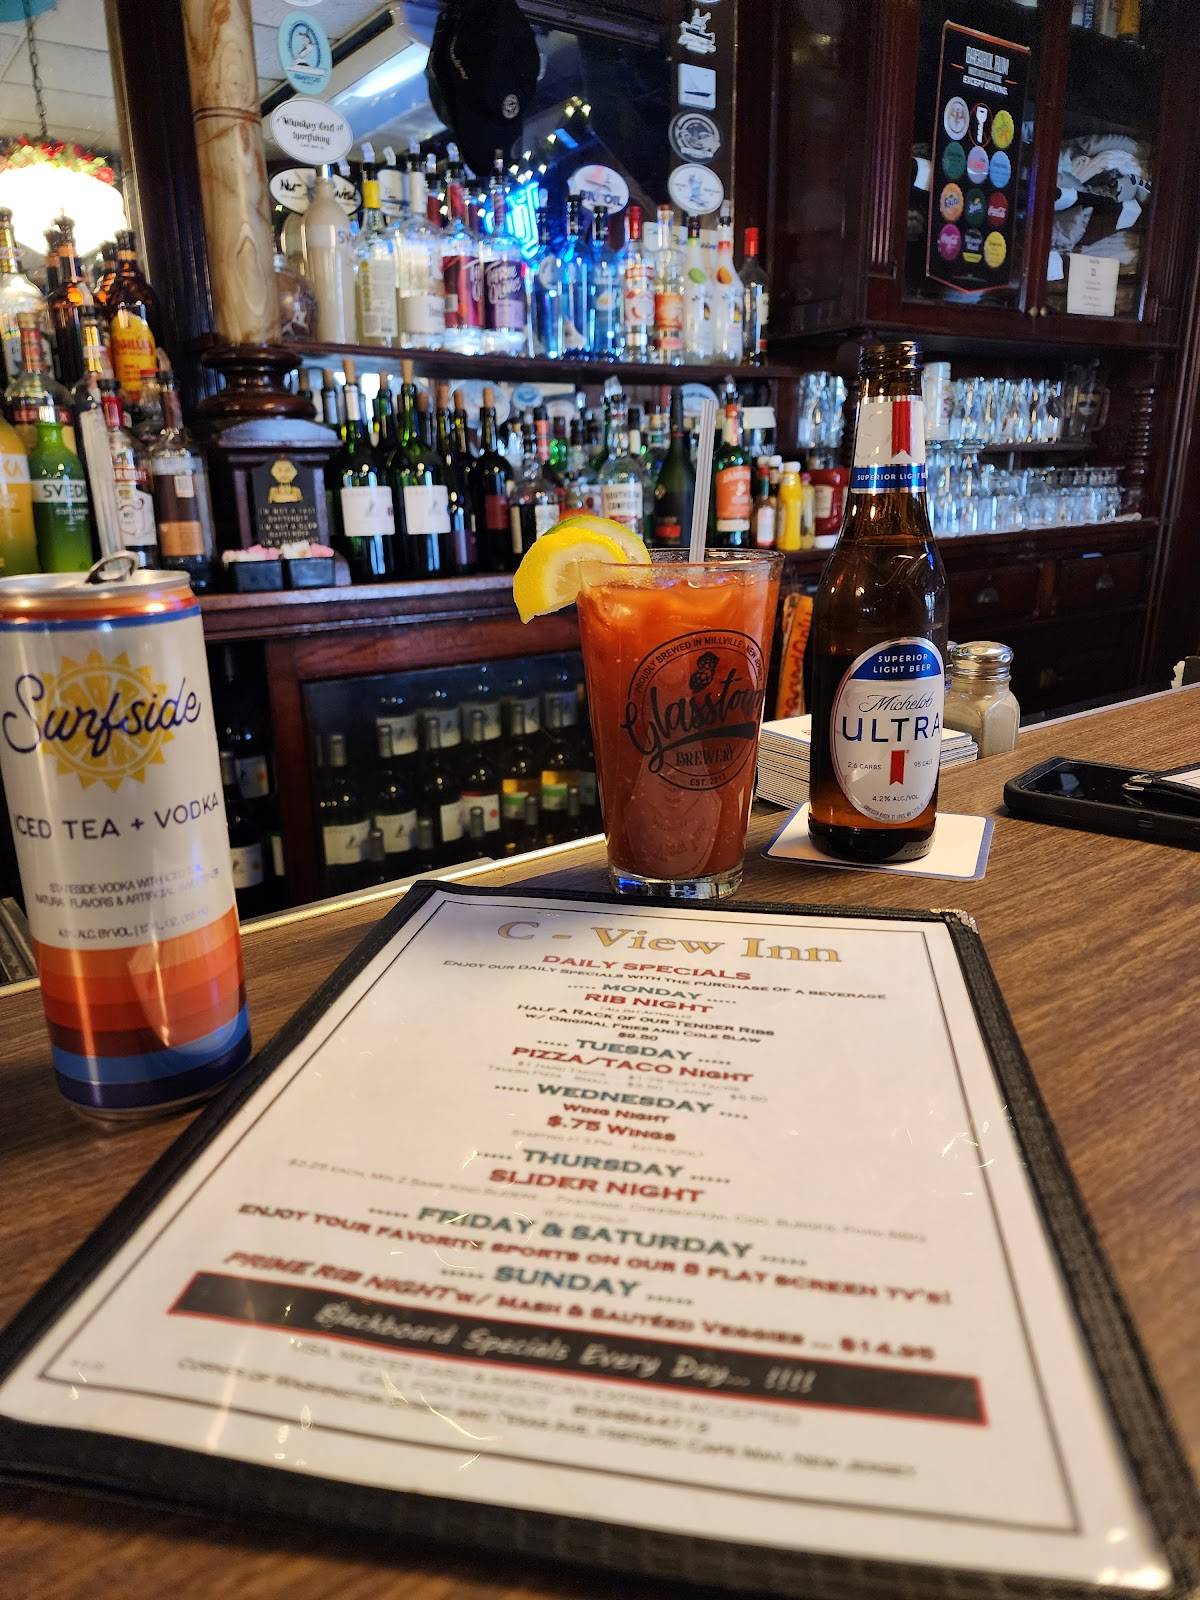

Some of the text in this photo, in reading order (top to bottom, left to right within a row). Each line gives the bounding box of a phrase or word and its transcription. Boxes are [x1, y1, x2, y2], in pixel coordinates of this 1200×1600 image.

[857, 472, 896, 481] SUPERIOR
[656, 642, 692, 664] BREWED
[873, 663, 931, 674] LIGHT BEER
[878, 653, 929, 664] SUPERIOR
[2, 673, 202, 758] Surfside
[842, 712, 941, 743] ULTRA
[872, 795, 891, 803] 4.2%
[62, 818, 122, 841] TEA
[154, 792, 220, 830] VODKA
[497, 920, 540, 941] C
[590, 926, 726, 956] View
[740, 936, 843, 964] Inn
[487, 963, 516, 971] OUR
[517, 963, 557, 974] DAILY
[559, 968, 624, 980] SPECIALS
[626, 974, 661, 982] WITH
[668, 976, 691, 986] THE
[693, 980, 770, 993] PURCHASE
[808, 990, 888, 1001] BEVERAGE
[541, 954, 752, 981] DAILY SPECIALS
[584, 992, 628, 1005] RIB
[632, 997, 714, 1014] NIGHT
[602, 983, 704, 1001] MONDAY
[516, 1003, 557, 1013] HALF
[571, 1008, 612, 1020] RACK
[638, 1016, 670, 1025] OUR
[673, 1020, 735, 1032] TENDER
[738, 1026, 776, 1037] RIBS
[548, 1015, 610, 1028] ORIGINAL
[611, 1022, 649, 1032] FRIES
[651, 1027, 680, 1036] AND
[682, 1030, 719, 1041] COLE
[721, 1034, 762, 1044] SLAW
[511, 1046, 673, 1074] PIZZA/TACO
[679, 1066, 755, 1083] NIGHT
[576, 1038, 693, 1061] TUESDAY
[536, 1082, 715, 1114] WEDNESDAY
[562, 1103, 671, 1125] WING NIGHT
[606, 1123, 677, 1142] WINGS
[523, 1149, 685, 1179] THURSDAY
[489, 1168, 705, 1204] SLIDER NIGHT
[417, 1206, 536, 1236] FRIDAY
[541, 1222, 566, 1239] &
[570, 1223, 754, 1258] SATURDAY
[237, 1203, 307, 1222] ENJOY
[375, 1224, 484, 1253] FAVORITE
[490, 1241, 580, 1263] SPORTS
[586, 1252, 621, 1267] ON
[626, 1257, 676, 1273] OUR
[706, 1265, 770, 1284] FLAT
[773, 1274, 878, 1298] SCREEN
[494, 1265, 640, 1298] SUNDAY
[223, 1250, 316, 1277] PRIME
[316, 1264, 362, 1283] RIB
[497, 1297, 560, 1318] MASH
[567, 1303, 585, 1318] &
[702, 1320, 805, 1347] VEGGIES
[461, 1327, 572, 1363] Specials
[577, 1342, 663, 1379] Every
